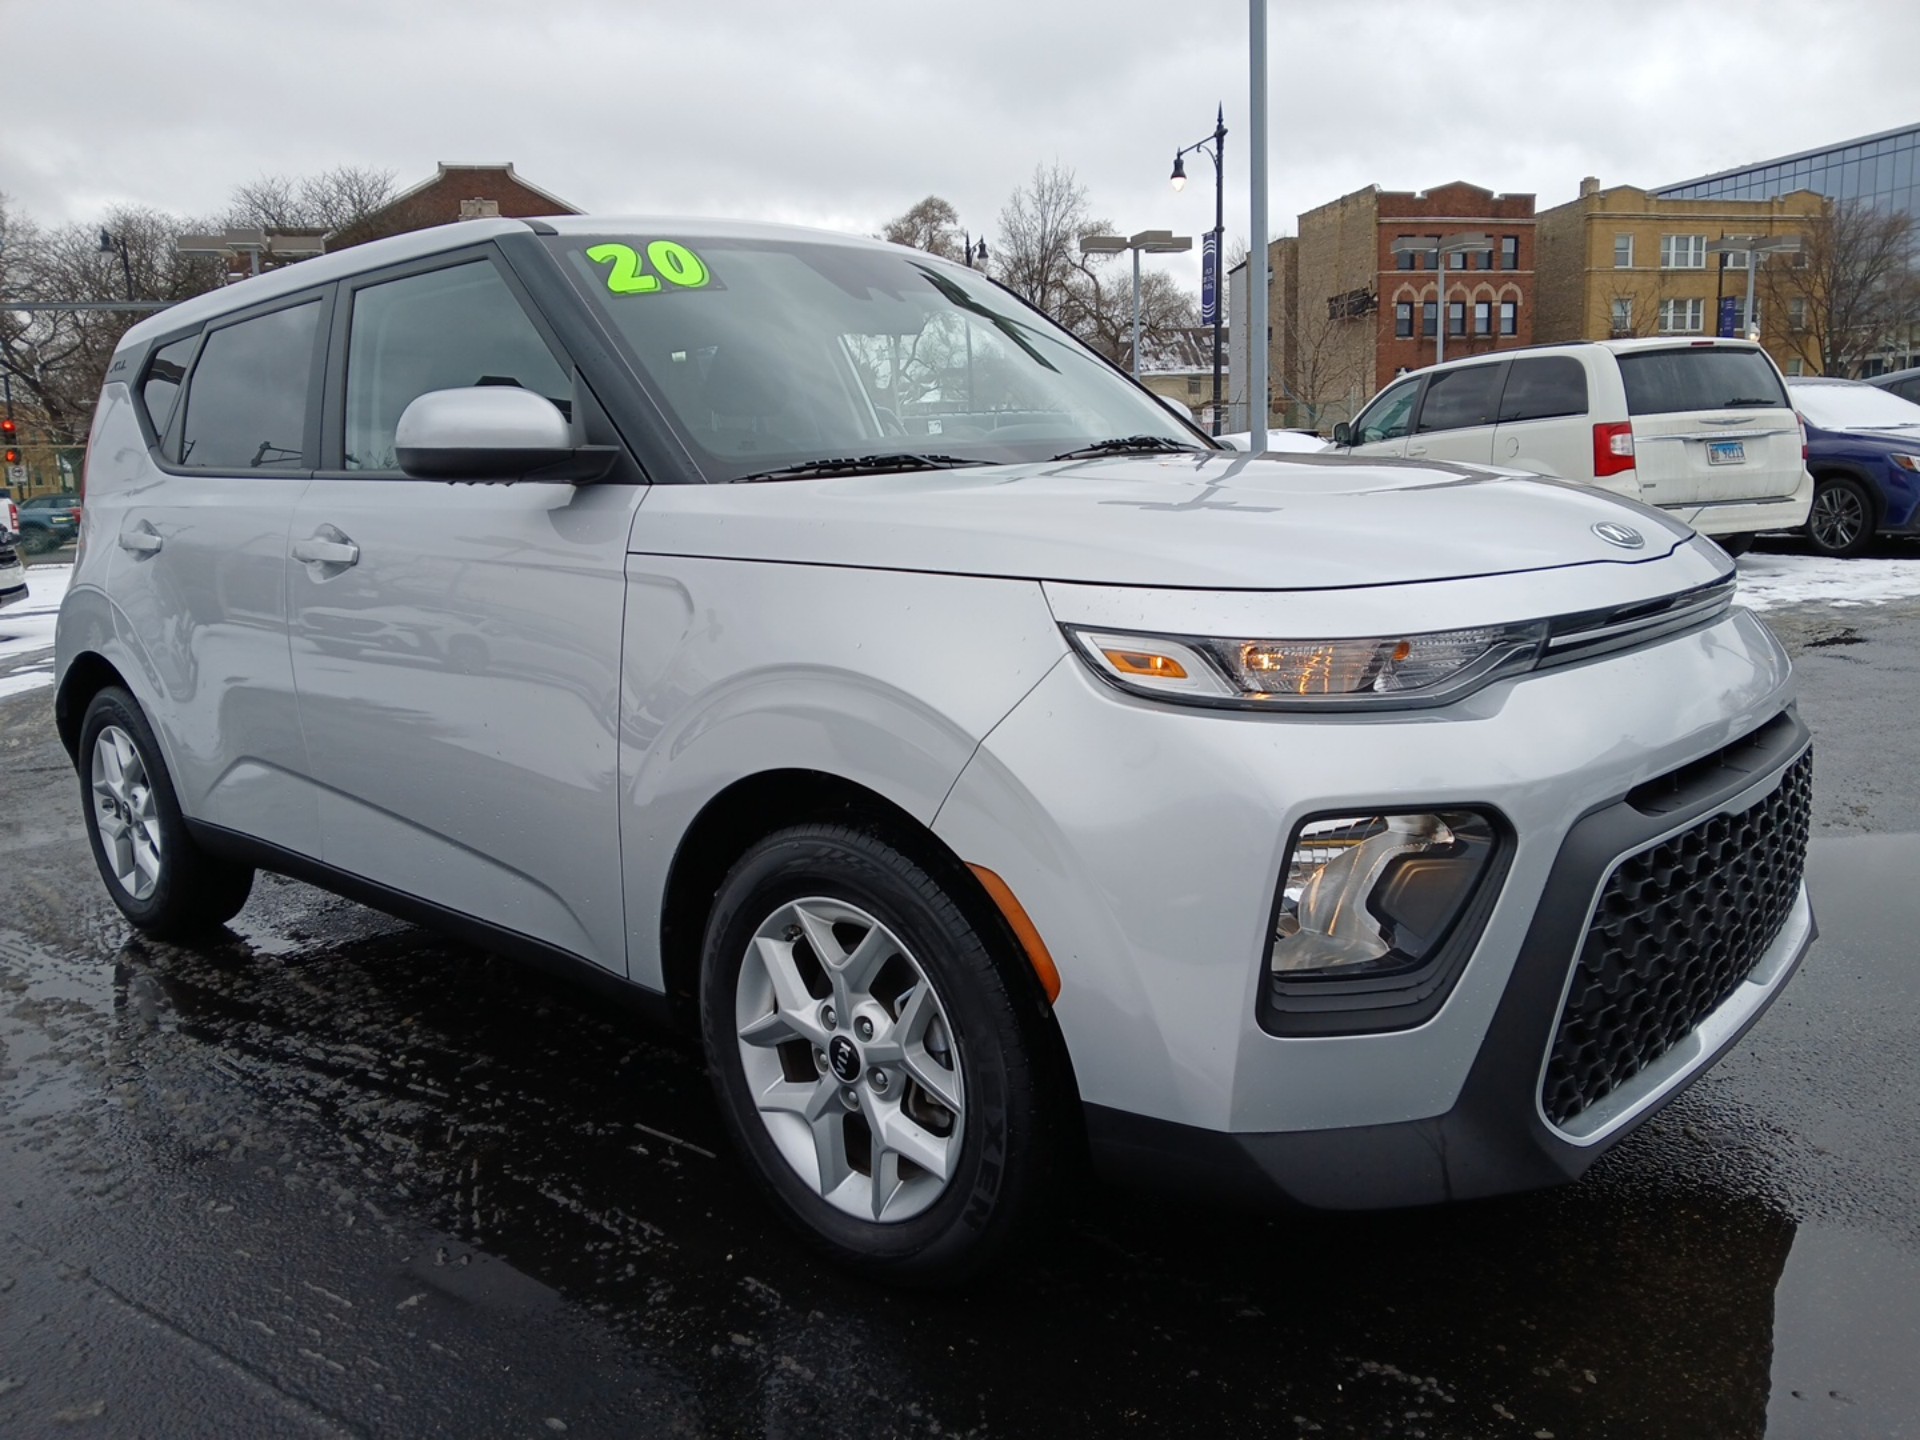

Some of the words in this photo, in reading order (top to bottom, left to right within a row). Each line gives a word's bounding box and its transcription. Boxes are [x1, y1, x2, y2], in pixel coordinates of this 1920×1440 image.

[586, 240, 710, 294] 20
[836, 1041, 852, 1075] KIA
[963, 1042, 1004, 1231] XEN
